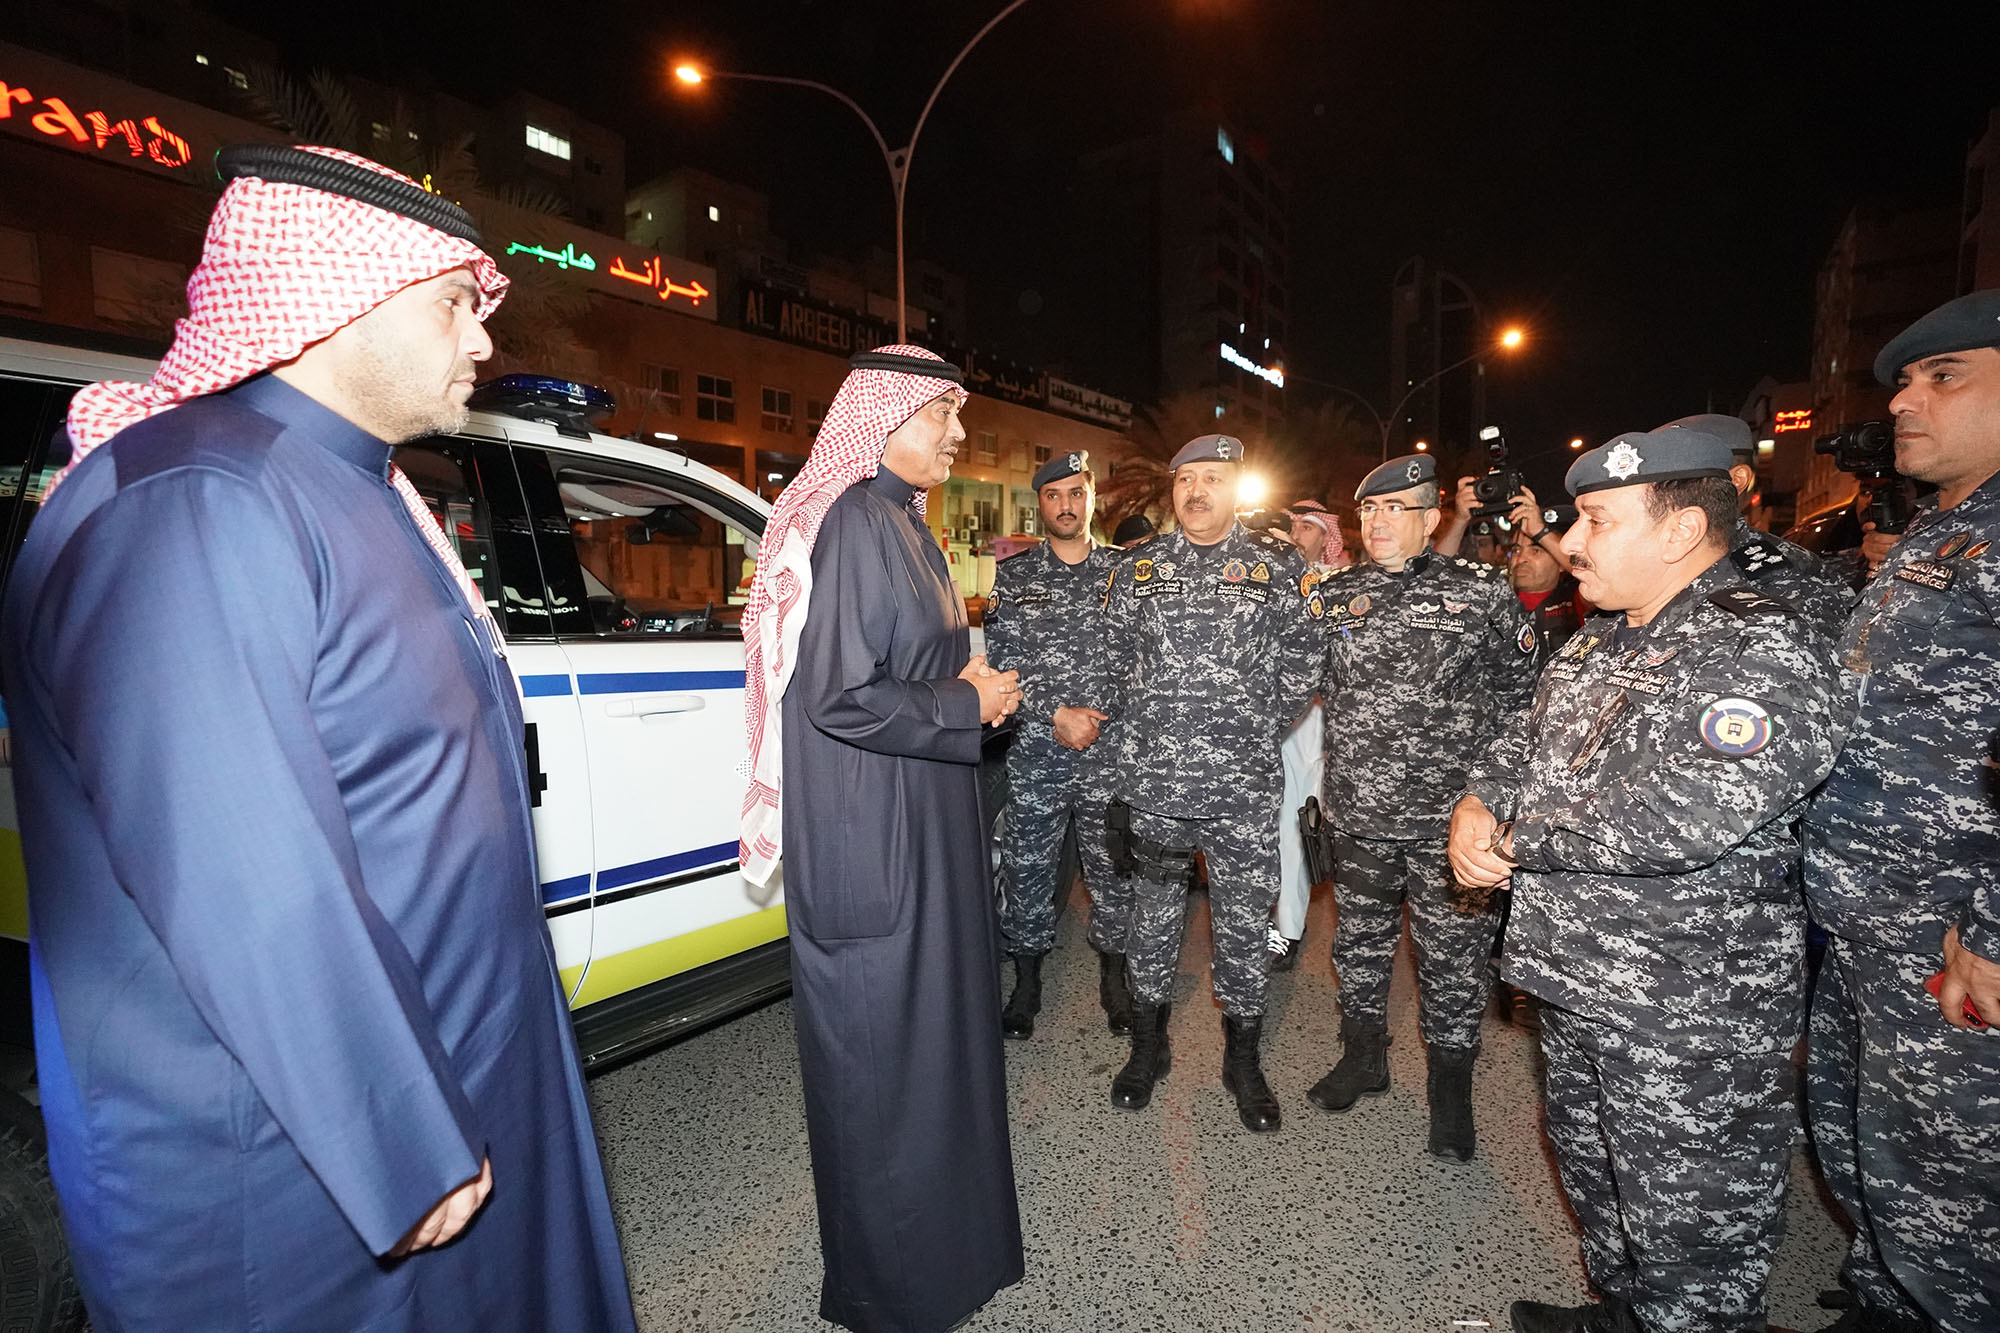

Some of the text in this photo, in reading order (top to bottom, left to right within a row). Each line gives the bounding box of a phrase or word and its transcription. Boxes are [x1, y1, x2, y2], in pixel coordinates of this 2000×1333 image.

[0, 80, 191, 168] rand
[609, 256, 709, 306] جراند
[746, 288, 776, 331] AL
[1912, 573, 1948, 590] FORCES
[1217, 588, 1266, 602] SPECIAL FORCES
[1410, 622, 1464, 633] SPECIAL FORCES
[1606, 676, 1662, 695] SPECIAL FORCES
